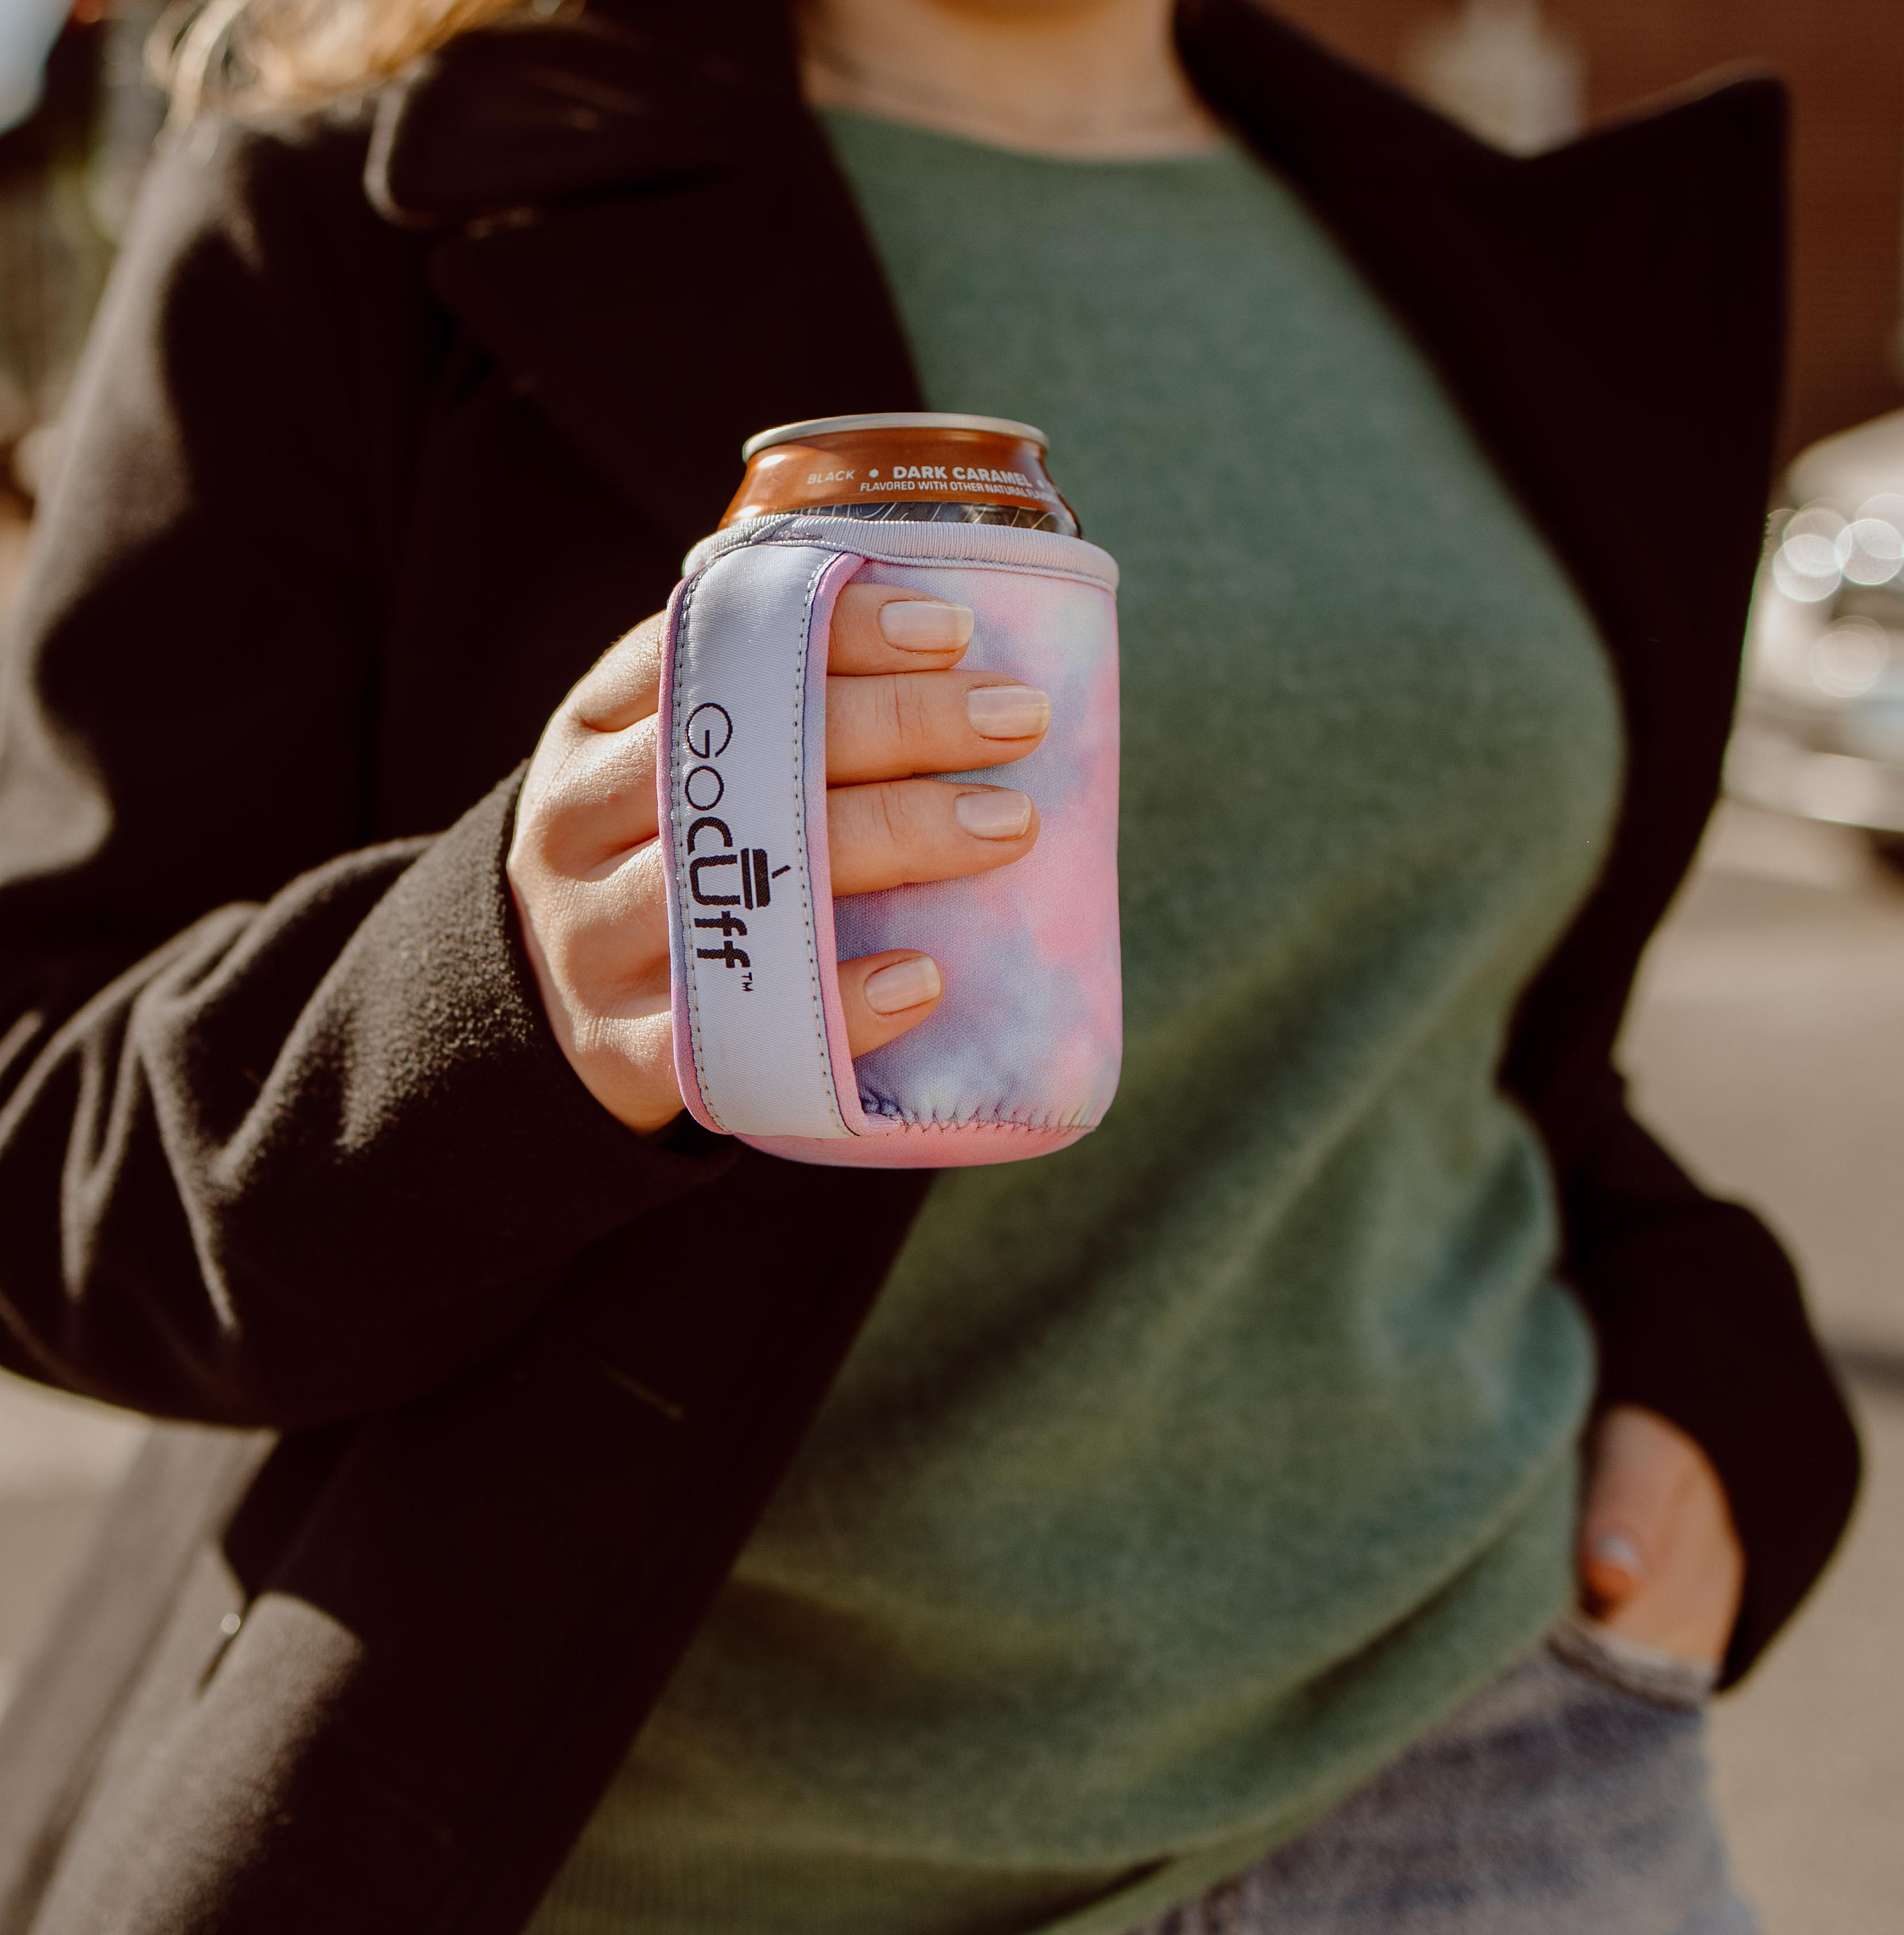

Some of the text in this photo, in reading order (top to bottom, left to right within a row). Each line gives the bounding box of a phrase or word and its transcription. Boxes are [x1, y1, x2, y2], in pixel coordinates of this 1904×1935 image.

[807, 466, 1033, 488] BLACK DARK CARAMEL
[860, 481, 915, 492] FLAVORED
[917, 481, 947, 491] WITH
[949, 482, 985, 493] OTHER
[986, 484, 1028, 498] NATURAL
